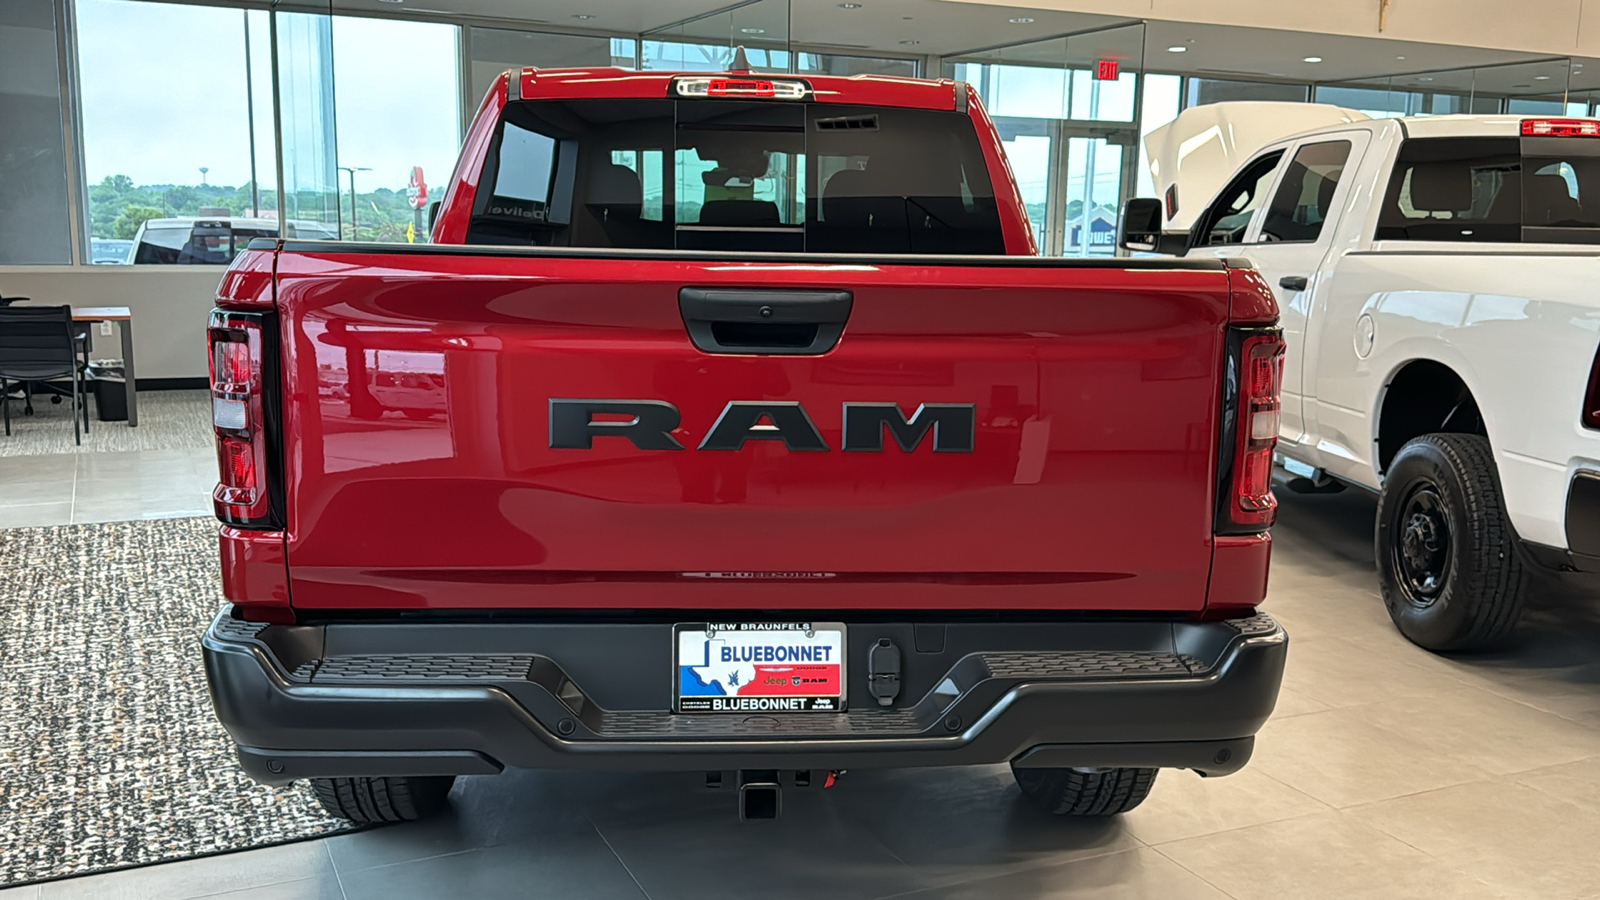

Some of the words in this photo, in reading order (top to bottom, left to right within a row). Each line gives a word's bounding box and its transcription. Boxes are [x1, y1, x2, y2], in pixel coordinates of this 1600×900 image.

[1098, 61, 1118, 80] EXIT
[548, 398, 976, 453] RAM
[709, 623, 737, 631] NEW
[740, 623, 810, 631] BRAUNFELS
[720, 645, 833, 662] BLUEBONNET
[763, 676, 788, 687] Jeep
[712, 698, 807, 711] BLUEBONNET
